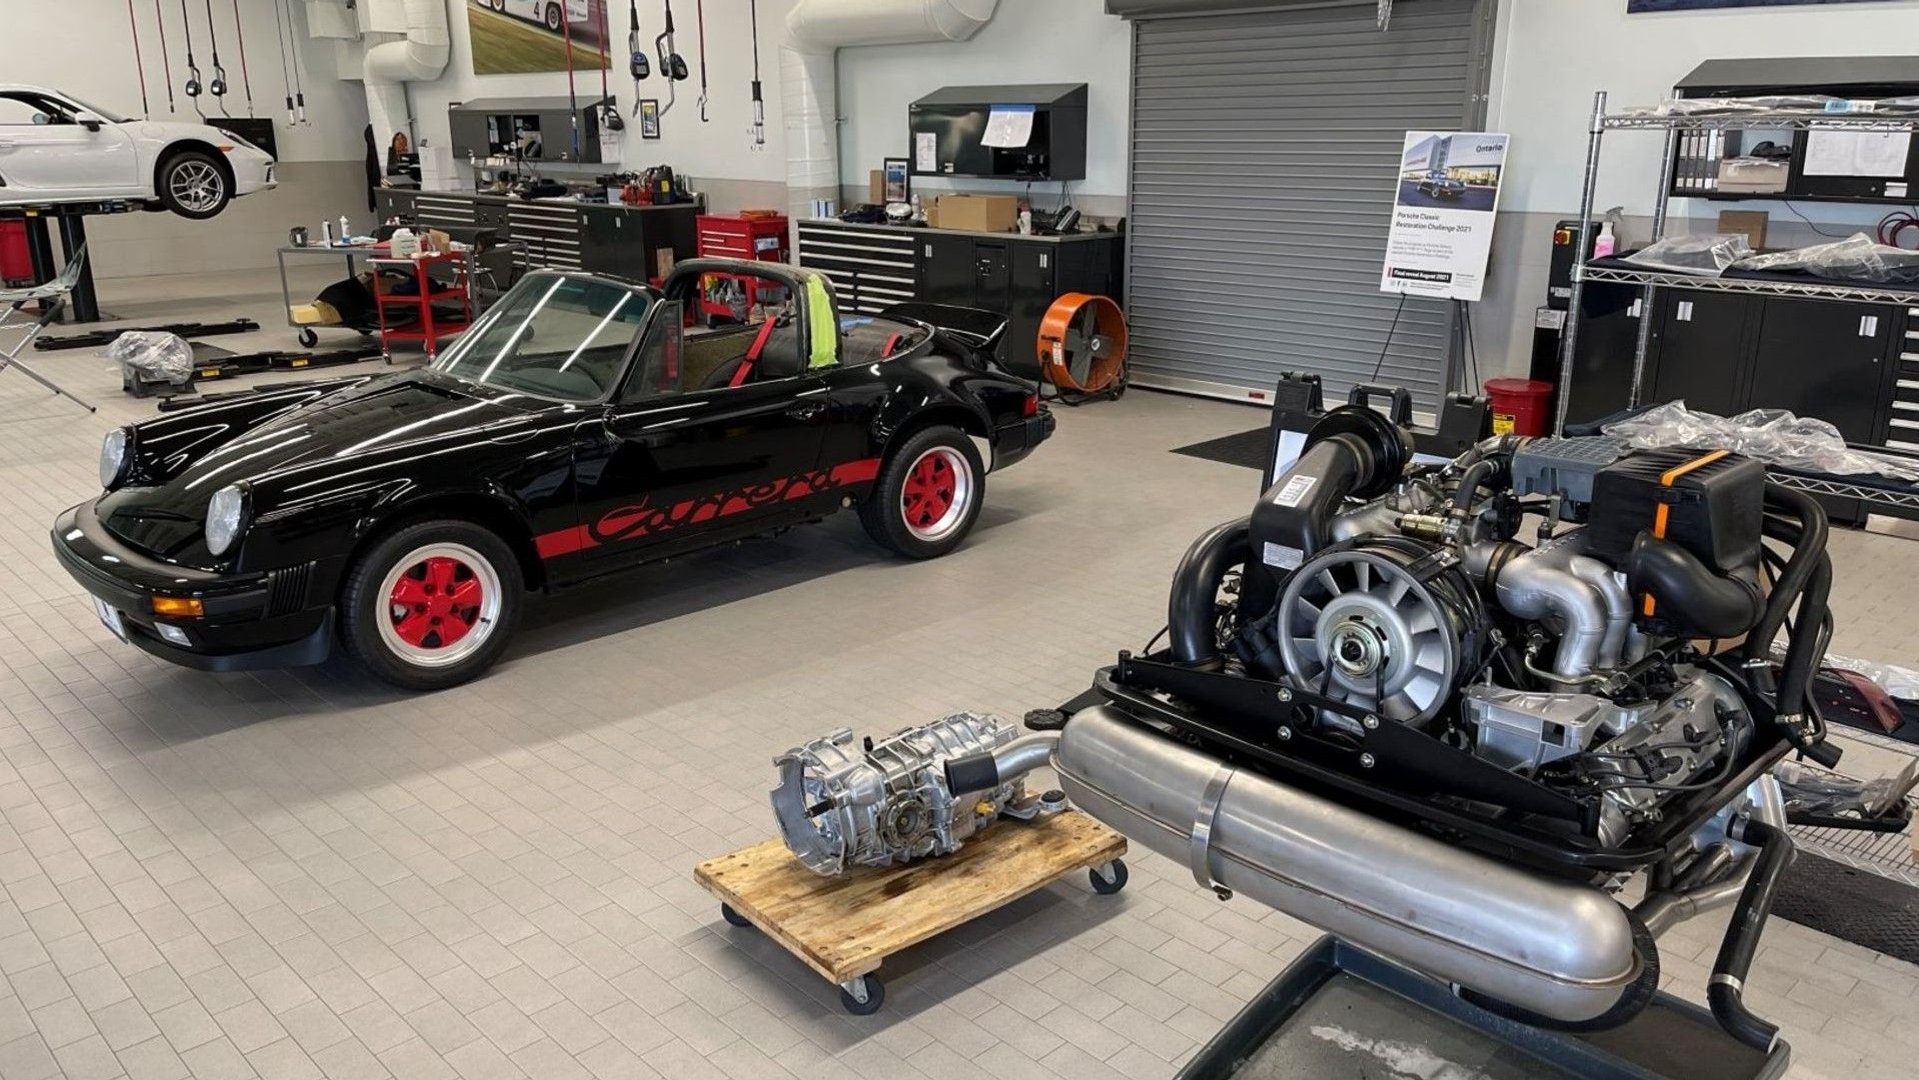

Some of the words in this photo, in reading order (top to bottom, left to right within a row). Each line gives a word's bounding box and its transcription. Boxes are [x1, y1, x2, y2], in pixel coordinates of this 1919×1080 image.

[533, 1, 541, 19] 4
[1475, 144, 1503, 153] Ontario
[1397, 212, 1420, 220] Porsche
[1420, 213, 1440, 221] Classic
[1395, 221, 1428, 230] Restoration
[1428, 223, 1456, 233] Challenge
[1456, 225, 1472, 233] 2021
[1419, 272, 1435, 280] August
[1435, 273, 1449, 281] 2021
[588, 470, 842, 545] Carrera
